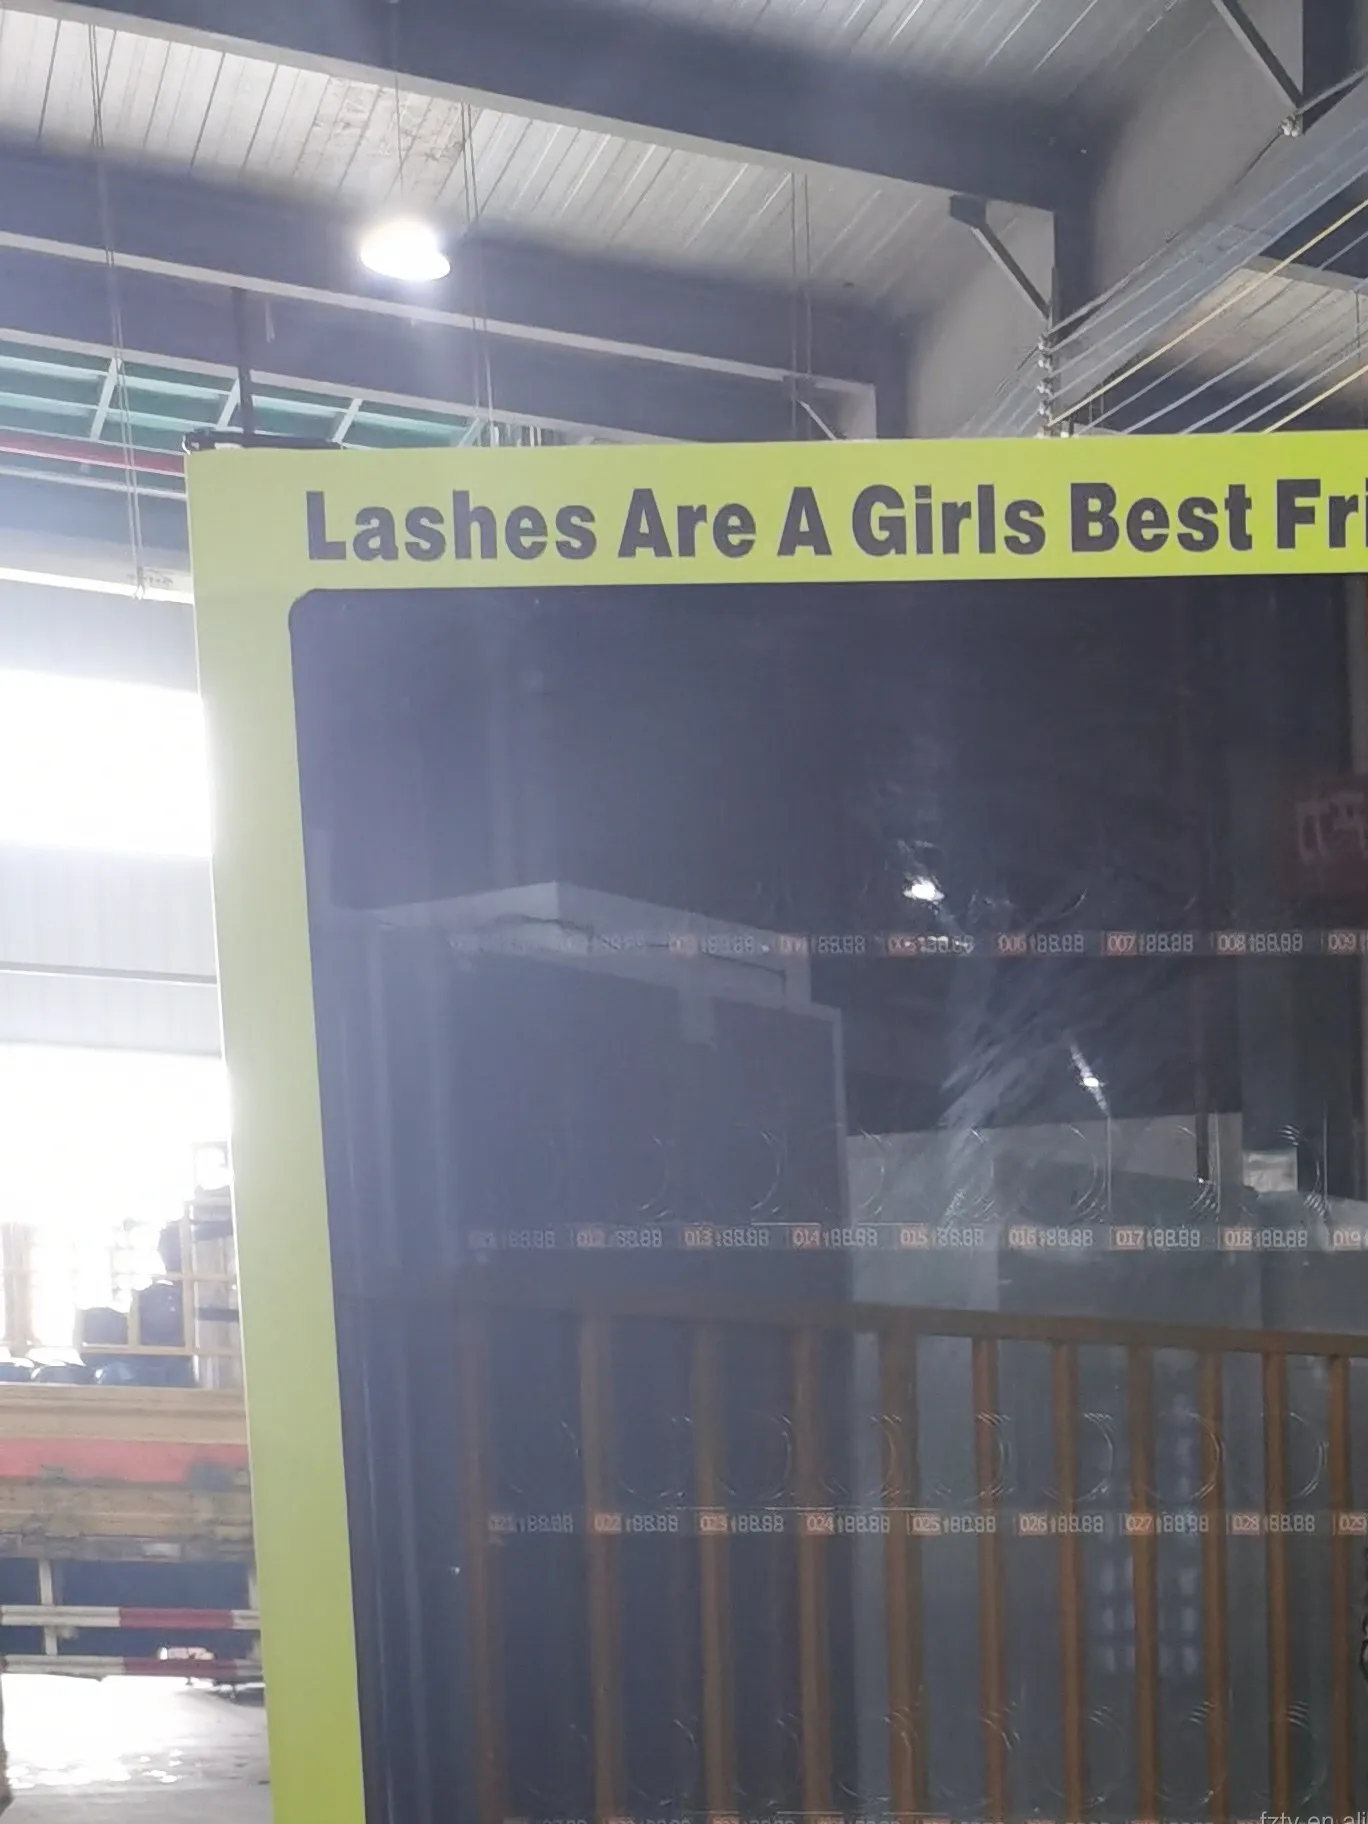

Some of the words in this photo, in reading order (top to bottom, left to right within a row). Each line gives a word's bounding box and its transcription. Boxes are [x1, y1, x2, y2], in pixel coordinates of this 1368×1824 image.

[306, 489, 597, 561] Lashes
[617, 487, 756, 558] Are
[776, 486, 832, 556] A
[851, 484, 1046, 556] Girls
[1070, 482, 1253, 553] Best
[1107, 934, 1135, 953] 007
[1217, 933, 1246, 952] 008
[1328, 933, 1357, 951] 009
[793, 1230, 821, 1247] 014
[900, 1230, 928, 1247] 015
[1008, 1230, 1037, 1247] 016
[1116, 1230, 1144, 1247] 017
[1224, 1230, 1252, 1247] 018
[1333, 1230, 1361, 1247] 019
[806, 1515, 834, 1532] 024
[912, 1515, 941, 1532] 025
[1020, 1515, 1048, 1533] 026
[1126, 1515, 1154, 1533] 027
[1232, 1515, 1260, 1533] 028
[1339, 1514, 1367, 1532] 029
